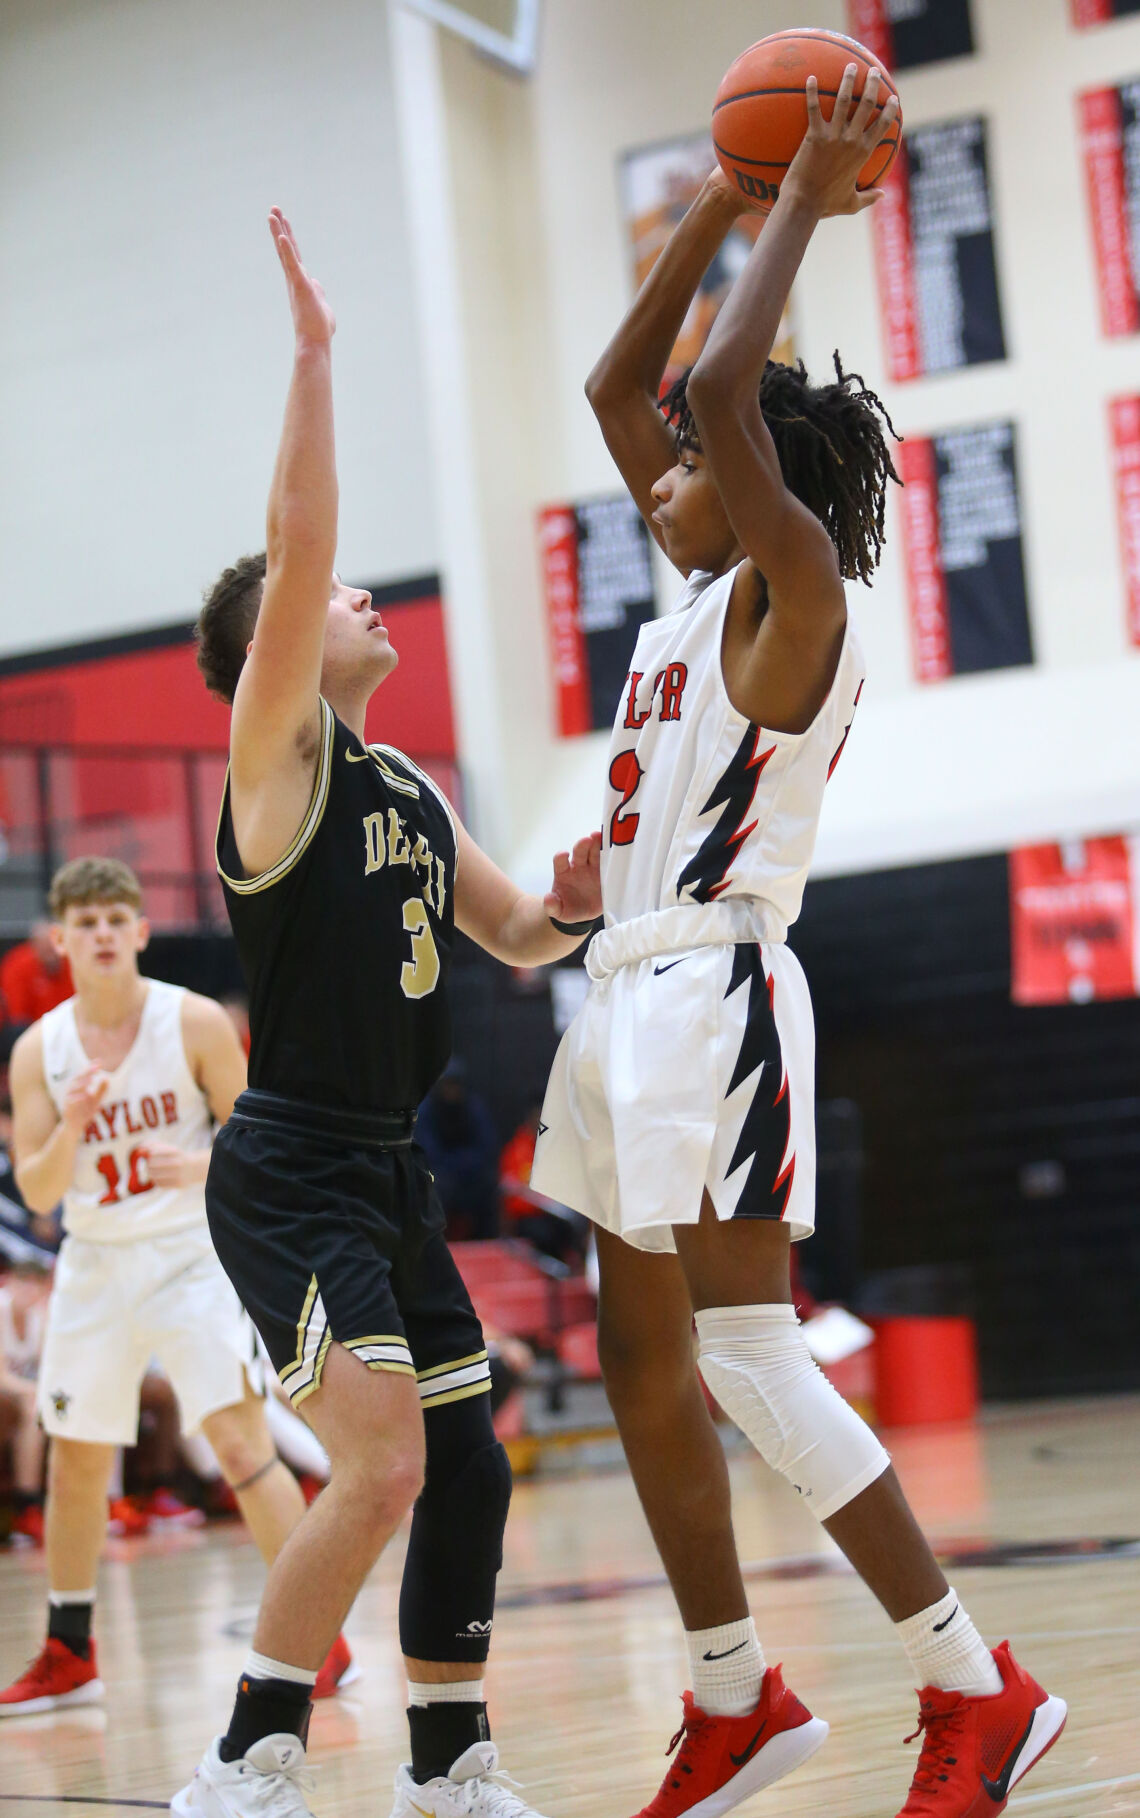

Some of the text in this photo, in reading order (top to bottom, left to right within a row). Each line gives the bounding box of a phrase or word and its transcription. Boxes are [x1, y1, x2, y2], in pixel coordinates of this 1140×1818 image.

[601, 748, 645, 851] 2
[400, 897, 440, 999] 3
[84, 1089, 179, 1144] AYLOR
